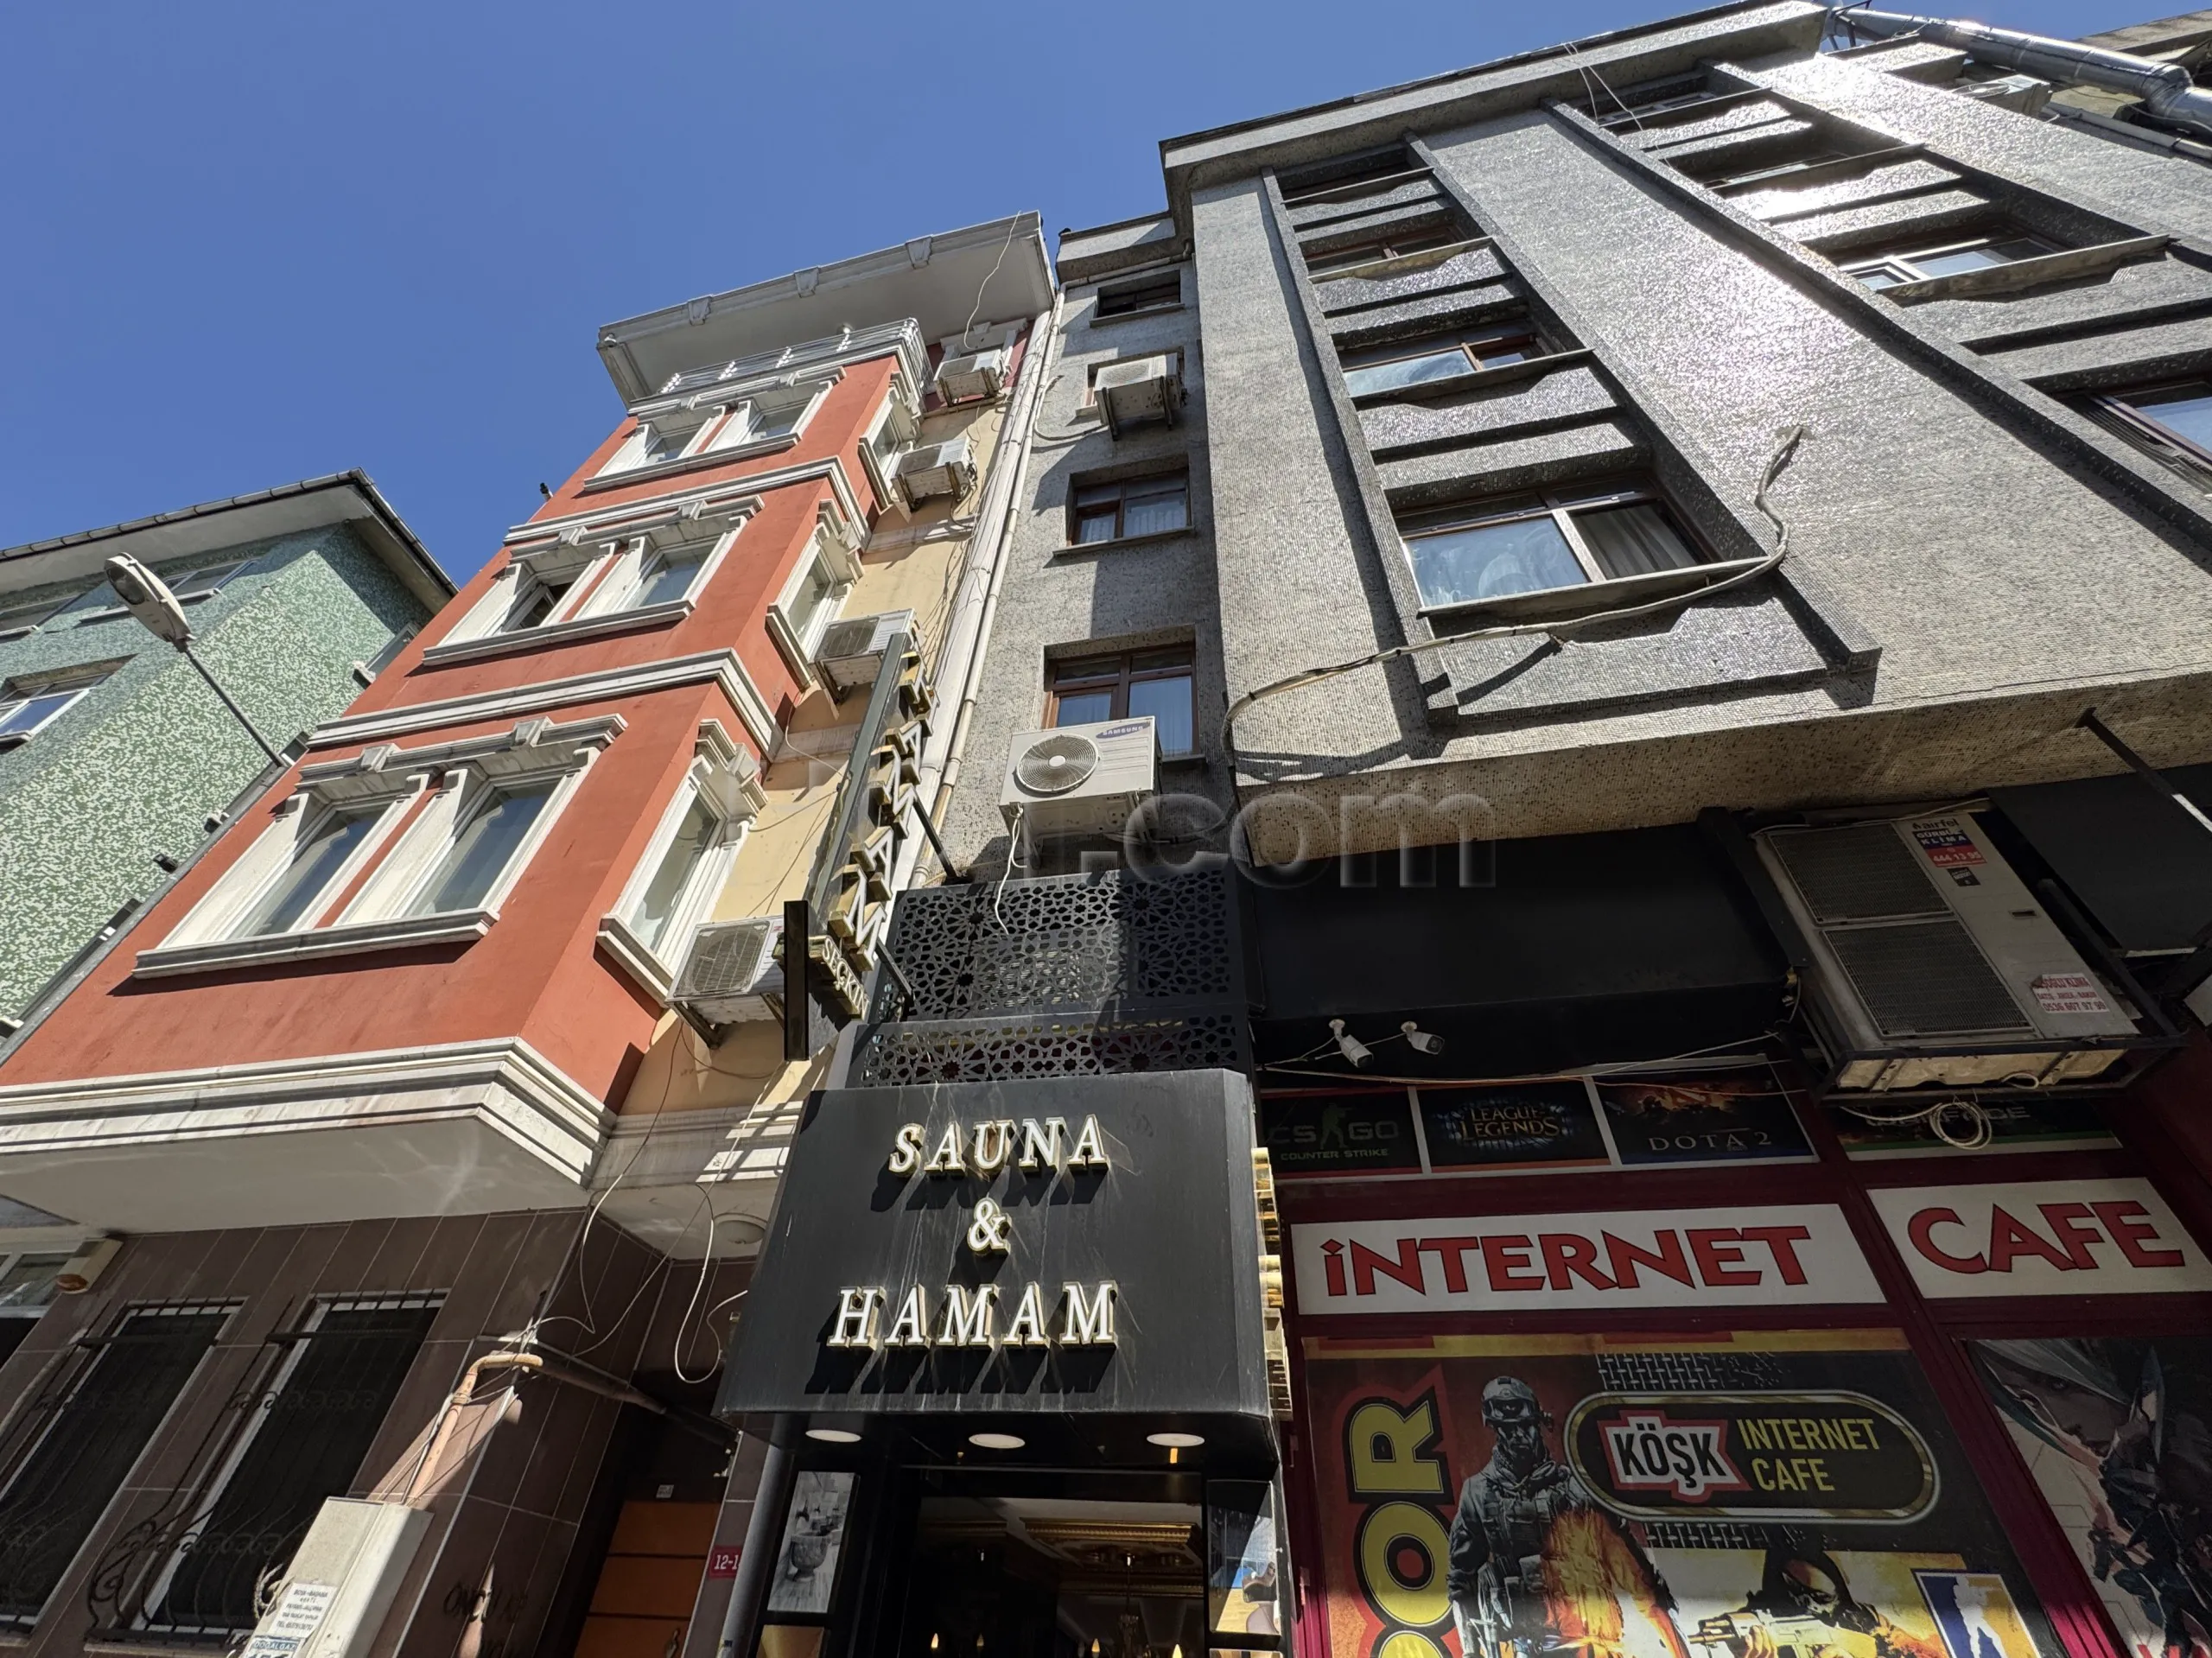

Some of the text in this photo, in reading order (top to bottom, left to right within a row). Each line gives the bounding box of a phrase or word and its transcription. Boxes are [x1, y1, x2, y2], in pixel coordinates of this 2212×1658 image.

[1102, 725, 1145, 736] SAMSUNG
[1933, 854, 1953, 862] 444
[1268, 1121, 1400, 1144] CS GO
[1459, 1115, 1560, 1141] LEGENDS
[1648, 1132, 1750, 1152] DOTA
[1753, 1131, 1772, 1146] 2
[888, 1114, 1112, 1178] SAUNA
[1281, 1147, 1390, 1161] COUNTER STRIKE
[967, 1197, 1012, 1255] &
[1907, 1201, 2185, 1274] CAFE
[827, 1280, 1119, 1350] HAMAM
[1737, 1417, 1881, 1452] INTERNET
[1613, 1420, 1728, 1489] KÖŞK
[1751, 1458, 1836, 1492] CAFE
[714, 1554, 741, 1571] 12-1
